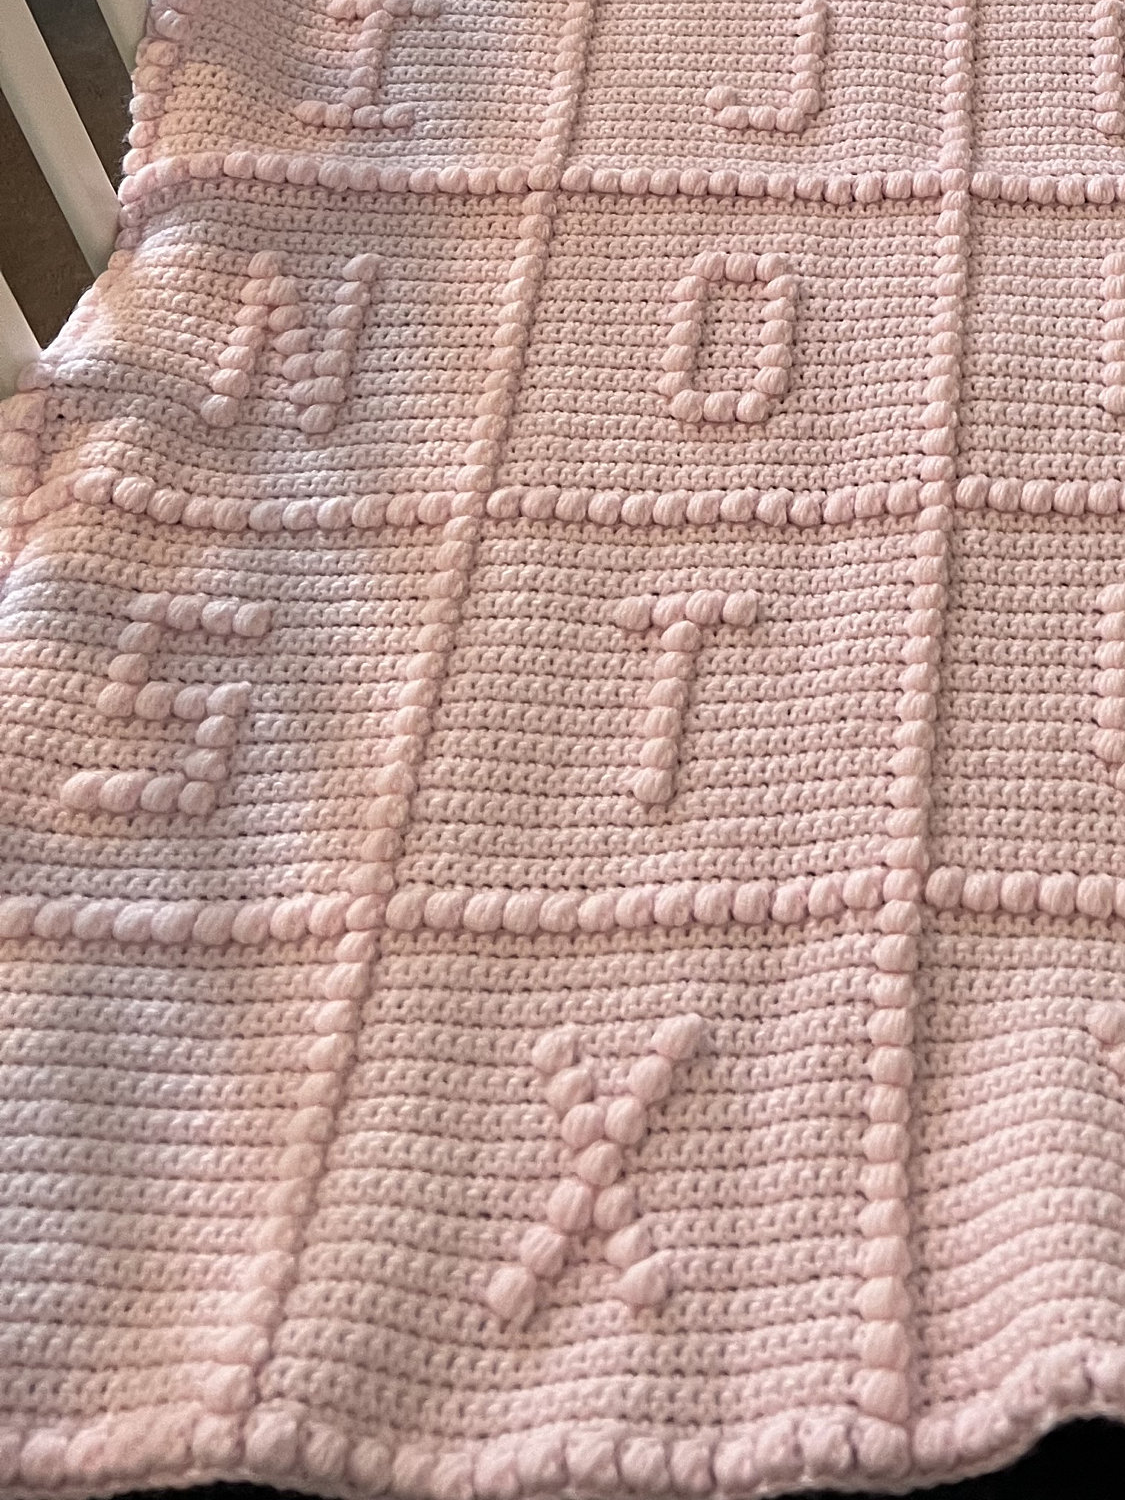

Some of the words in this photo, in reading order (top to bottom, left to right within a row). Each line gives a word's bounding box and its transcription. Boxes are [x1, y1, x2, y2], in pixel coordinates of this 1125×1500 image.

[201, 249, 385, 435] N
[658, 250, 798, 425] O
[59, 589, 274, 818] S
[613, 588, 759, 806] T
[485, 1012, 706, 1325] X
